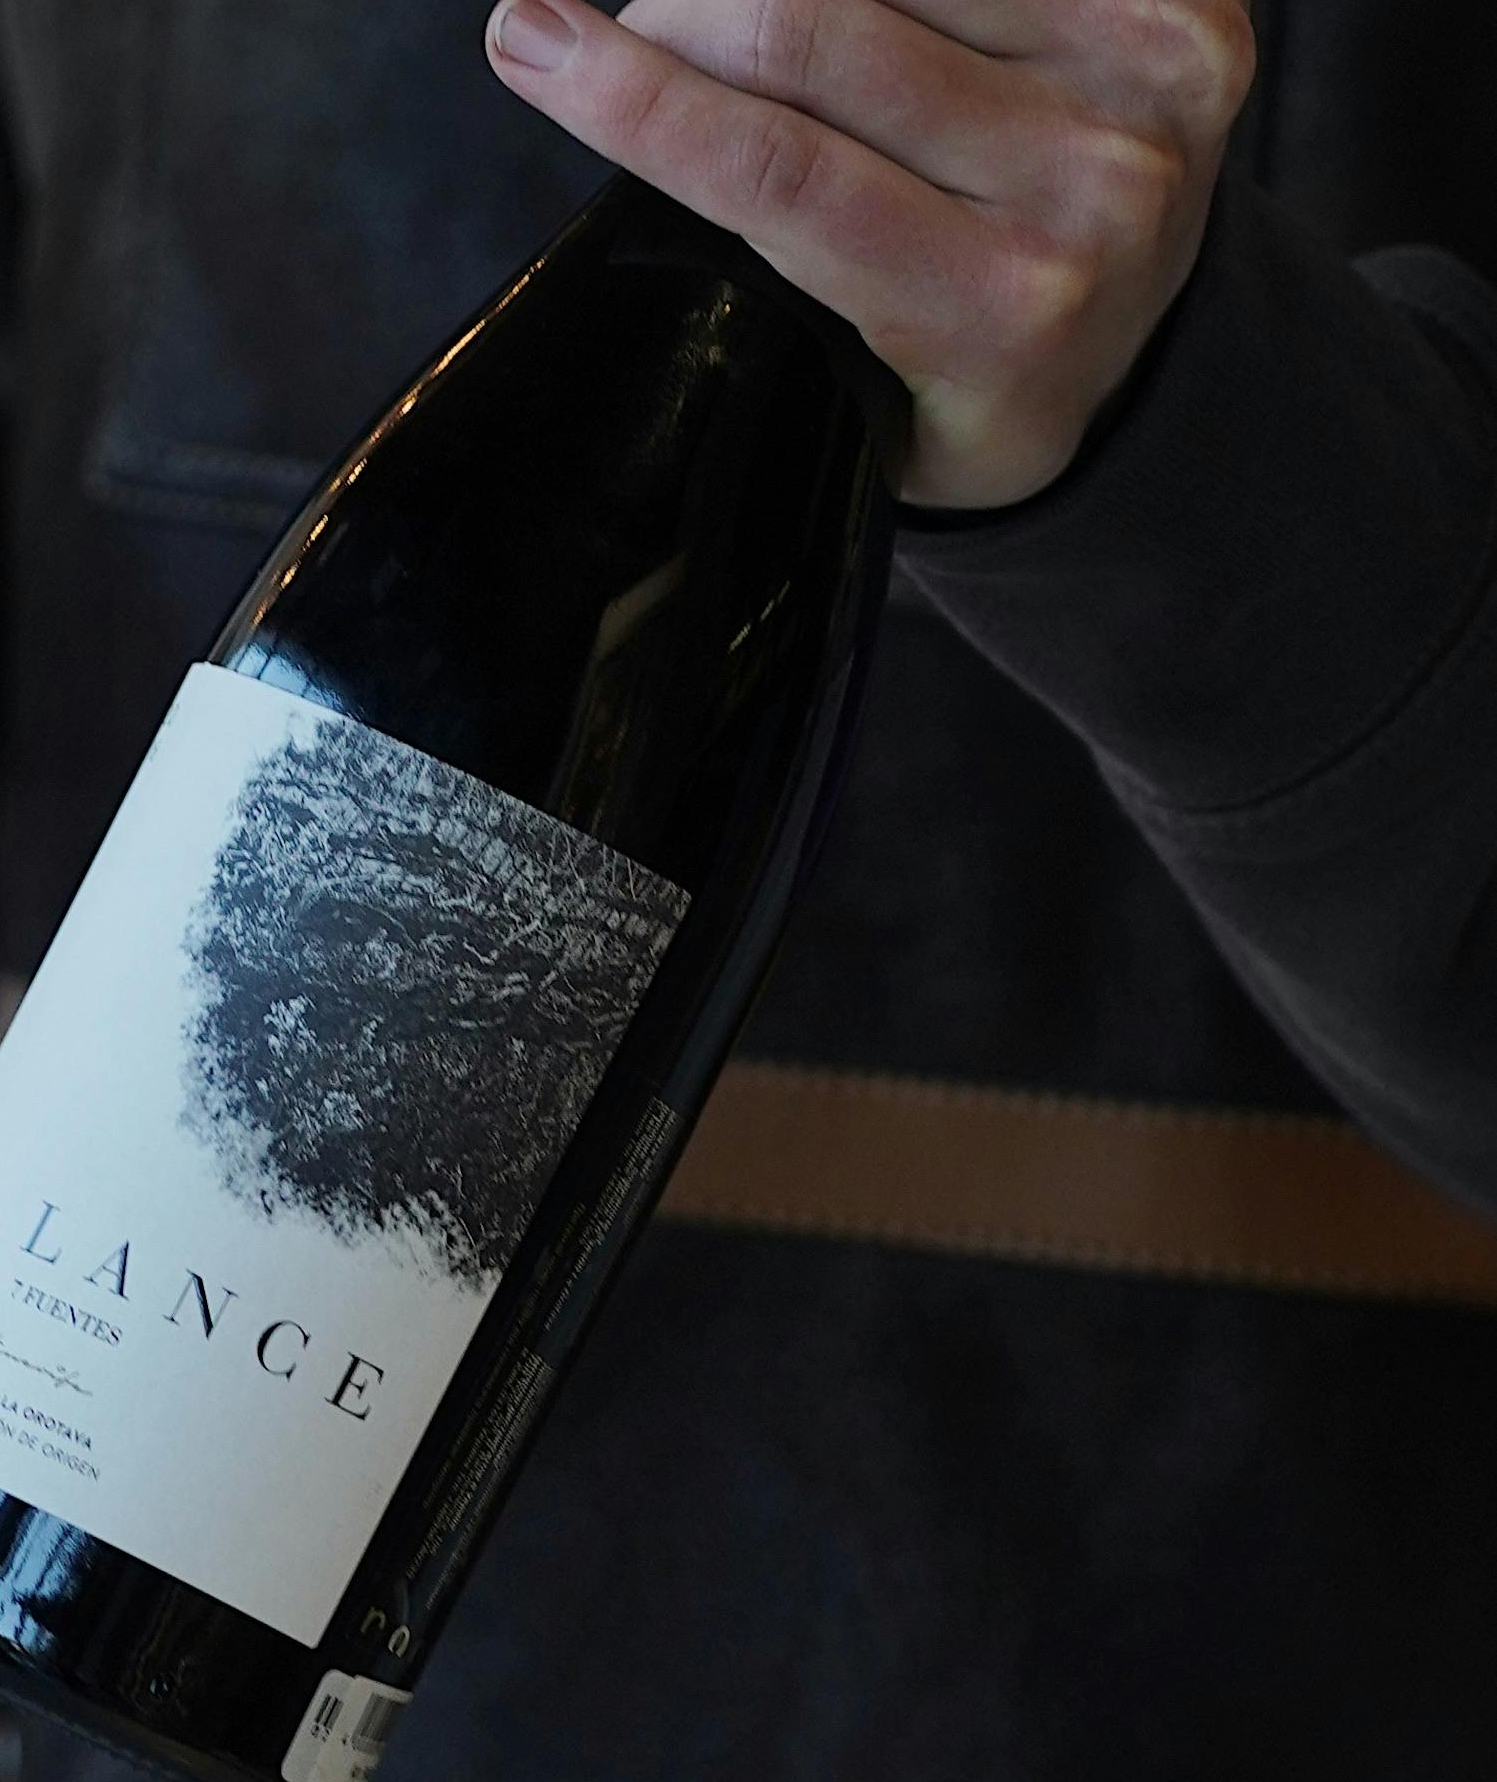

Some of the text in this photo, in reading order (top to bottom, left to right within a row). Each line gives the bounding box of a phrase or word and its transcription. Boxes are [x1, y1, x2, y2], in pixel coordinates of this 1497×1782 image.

[19, 1199, 385, 1421] LANCE
[23, 1285, 124, 1346] FUENTES
[0, 1394, 19, 1415] LA
[23, 1406, 92, 1451] OROTAVA
[17, 1430, 39, 1451] DE
[41, 1443, 101, 1482] ORIGEN
